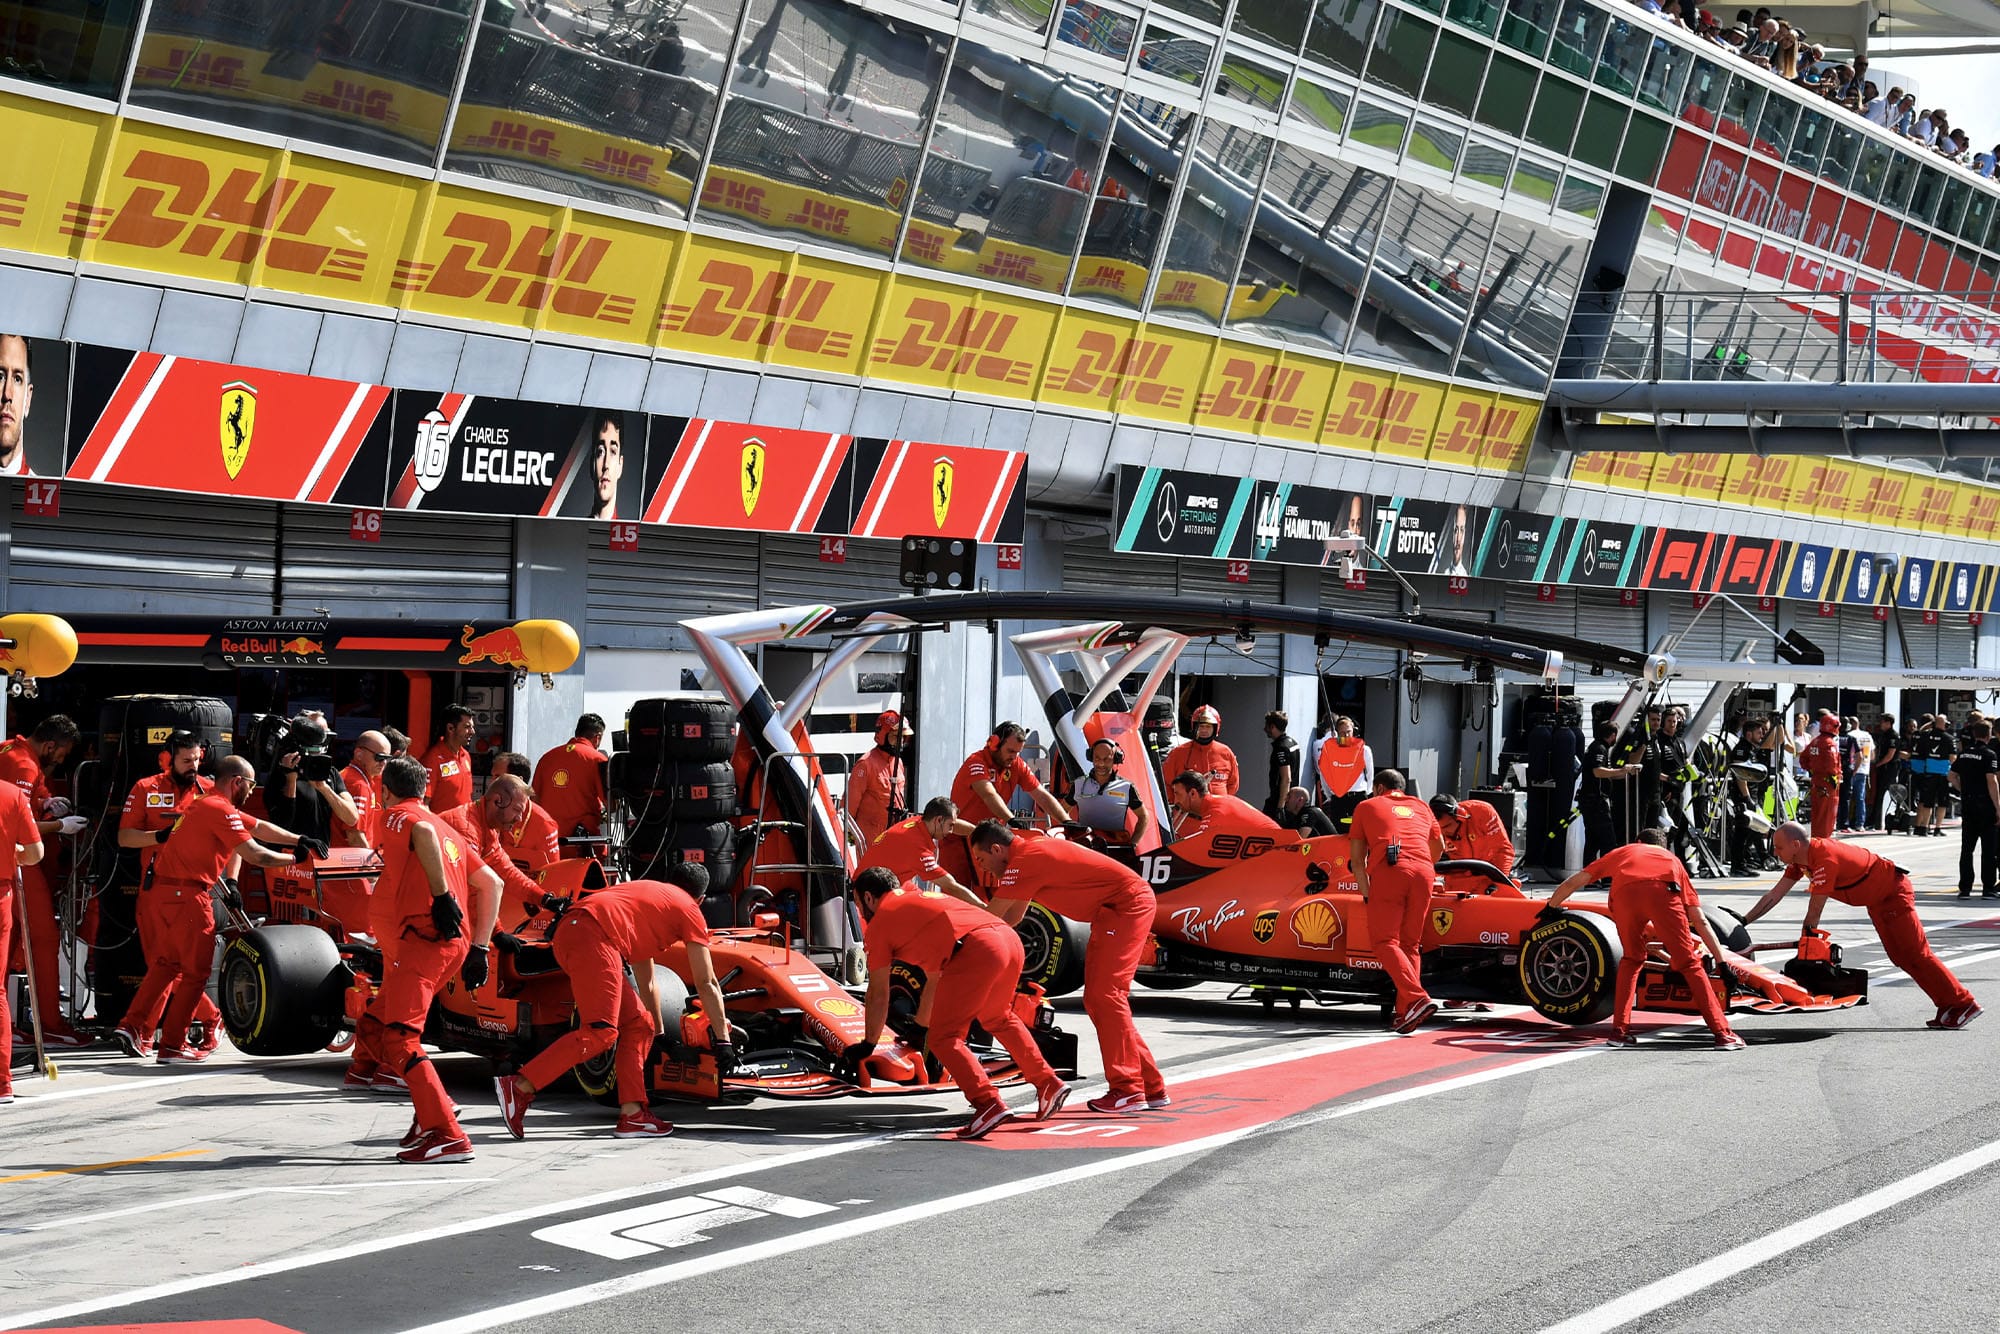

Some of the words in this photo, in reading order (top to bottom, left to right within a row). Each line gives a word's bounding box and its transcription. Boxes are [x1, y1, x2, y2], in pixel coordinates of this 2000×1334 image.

[102, 150, 336, 276] DHL
[425, 212, 613, 319] DHL
[682, 260, 835, 353] DHL
[892, 298, 1019, 381] DHL
[1063, 331, 1173, 405] DHL
[1210, 359, 1305, 427] DHL
[1335, 382, 1419, 446] DHL
[464, 426, 509, 446] CHARLES
[1446, 401, 1520, 459] DHL
[414, 420, 450, 477] 16
[461, 447, 555, 486] LECLERC
[1736, 454, 1789, 501] DHL
[27, 482, 57, 505] 17
[1801, 466, 1850, 509] DHL
[1861, 477, 1904, 518] DHL
[1180, 509, 1217, 523] PETRONAS
[1914, 487, 1954, 526] DHL
[1962, 495, 2000, 532] DHL
[351, 511, 379, 533] 16
[1184, 524, 1216, 535] MOTORSPORT
[1256, 491, 1281, 552] 44
[1283, 517, 1331, 541] HAMILTON
[1376, 505, 1398, 560] 77
[611, 525, 637, 543] 15
[1397, 529, 1436, 555] BOTTAS
[821, 540, 845, 555] 14
[998, 547, 1020, 563] 13
[1228, 563, 1248, 575] 12
[1450, 578, 1467, 589] 10
[1542, 585, 1551, 596] 9
[1625, 591, 1633, 600] 8
[1763, 598, 1770, 607] 6
[224, 620, 269, 630] ASTON
[273, 620, 329, 631] MARTIN
[221, 638, 249, 653] Red
[250, 638, 277, 653] Bull
[224, 655, 328, 664] RACING
[153, 731, 167, 741] 42
[686, 727, 697, 736] 14
[285, 864, 314, 880] V-Power
[1139, 856, 1173, 884] 16
[1253, 917, 1275, 939] ups
[1532, 919, 1568, 942] PIRELLI
[1045, 936, 1063, 976] PIRELLI
[1349, 957, 1383, 970] Lenov
[788, 973, 830, 993] 5
[890, 965, 922, 990] ERO
[1329, 968, 1354, 981] infor
[1544, 993, 1591, 1014] ZERO
[478, 1017, 509, 1033] Lenovo
[770, 1076, 825, 1087] V-Power
